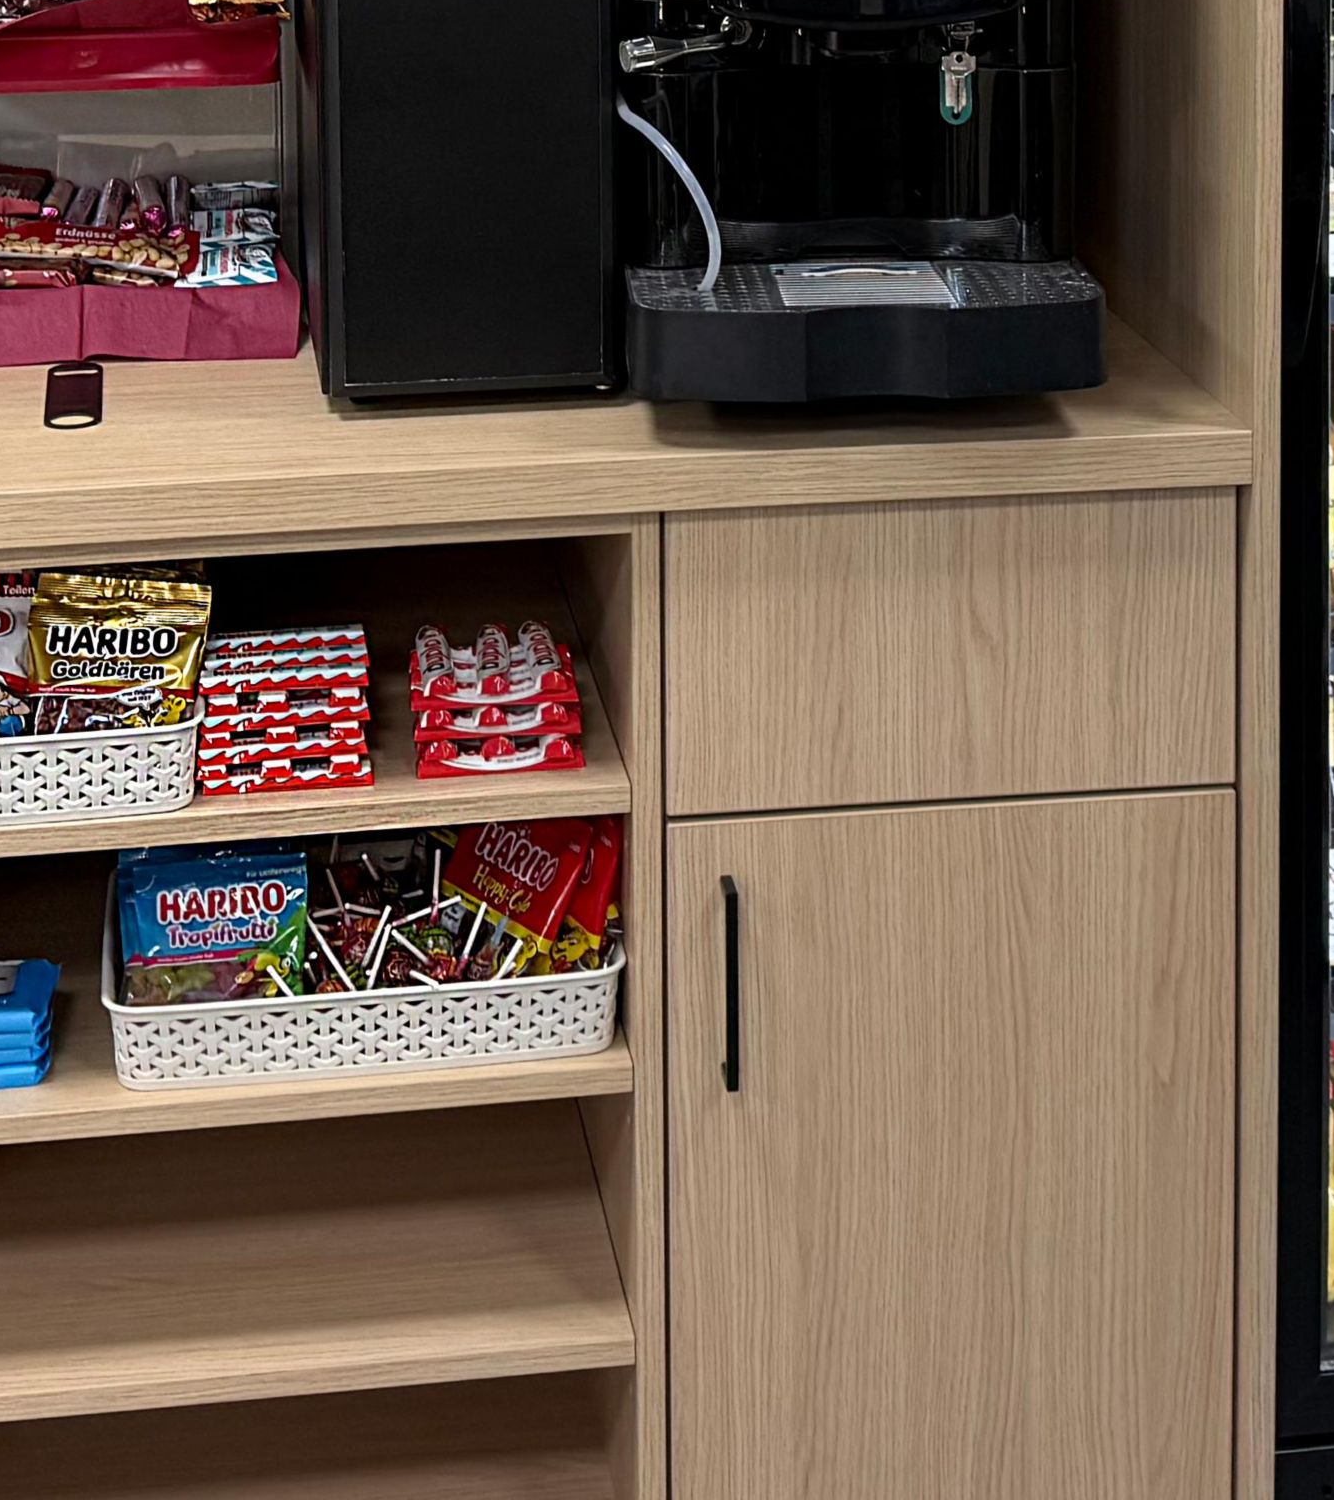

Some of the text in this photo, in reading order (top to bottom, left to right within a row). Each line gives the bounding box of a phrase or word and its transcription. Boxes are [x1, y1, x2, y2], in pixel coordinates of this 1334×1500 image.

[55, 227, 117, 240] Erdnüsse
[3, 585, 36, 596] Teilen
[46, 624, 178, 658] HARIBO
[51, 660, 165, 680] Goldbären
[475, 822, 559, 891] HARIBO
[157, 880, 286, 924] HARIBO
[168, 916, 278, 948] Tropifrutti
